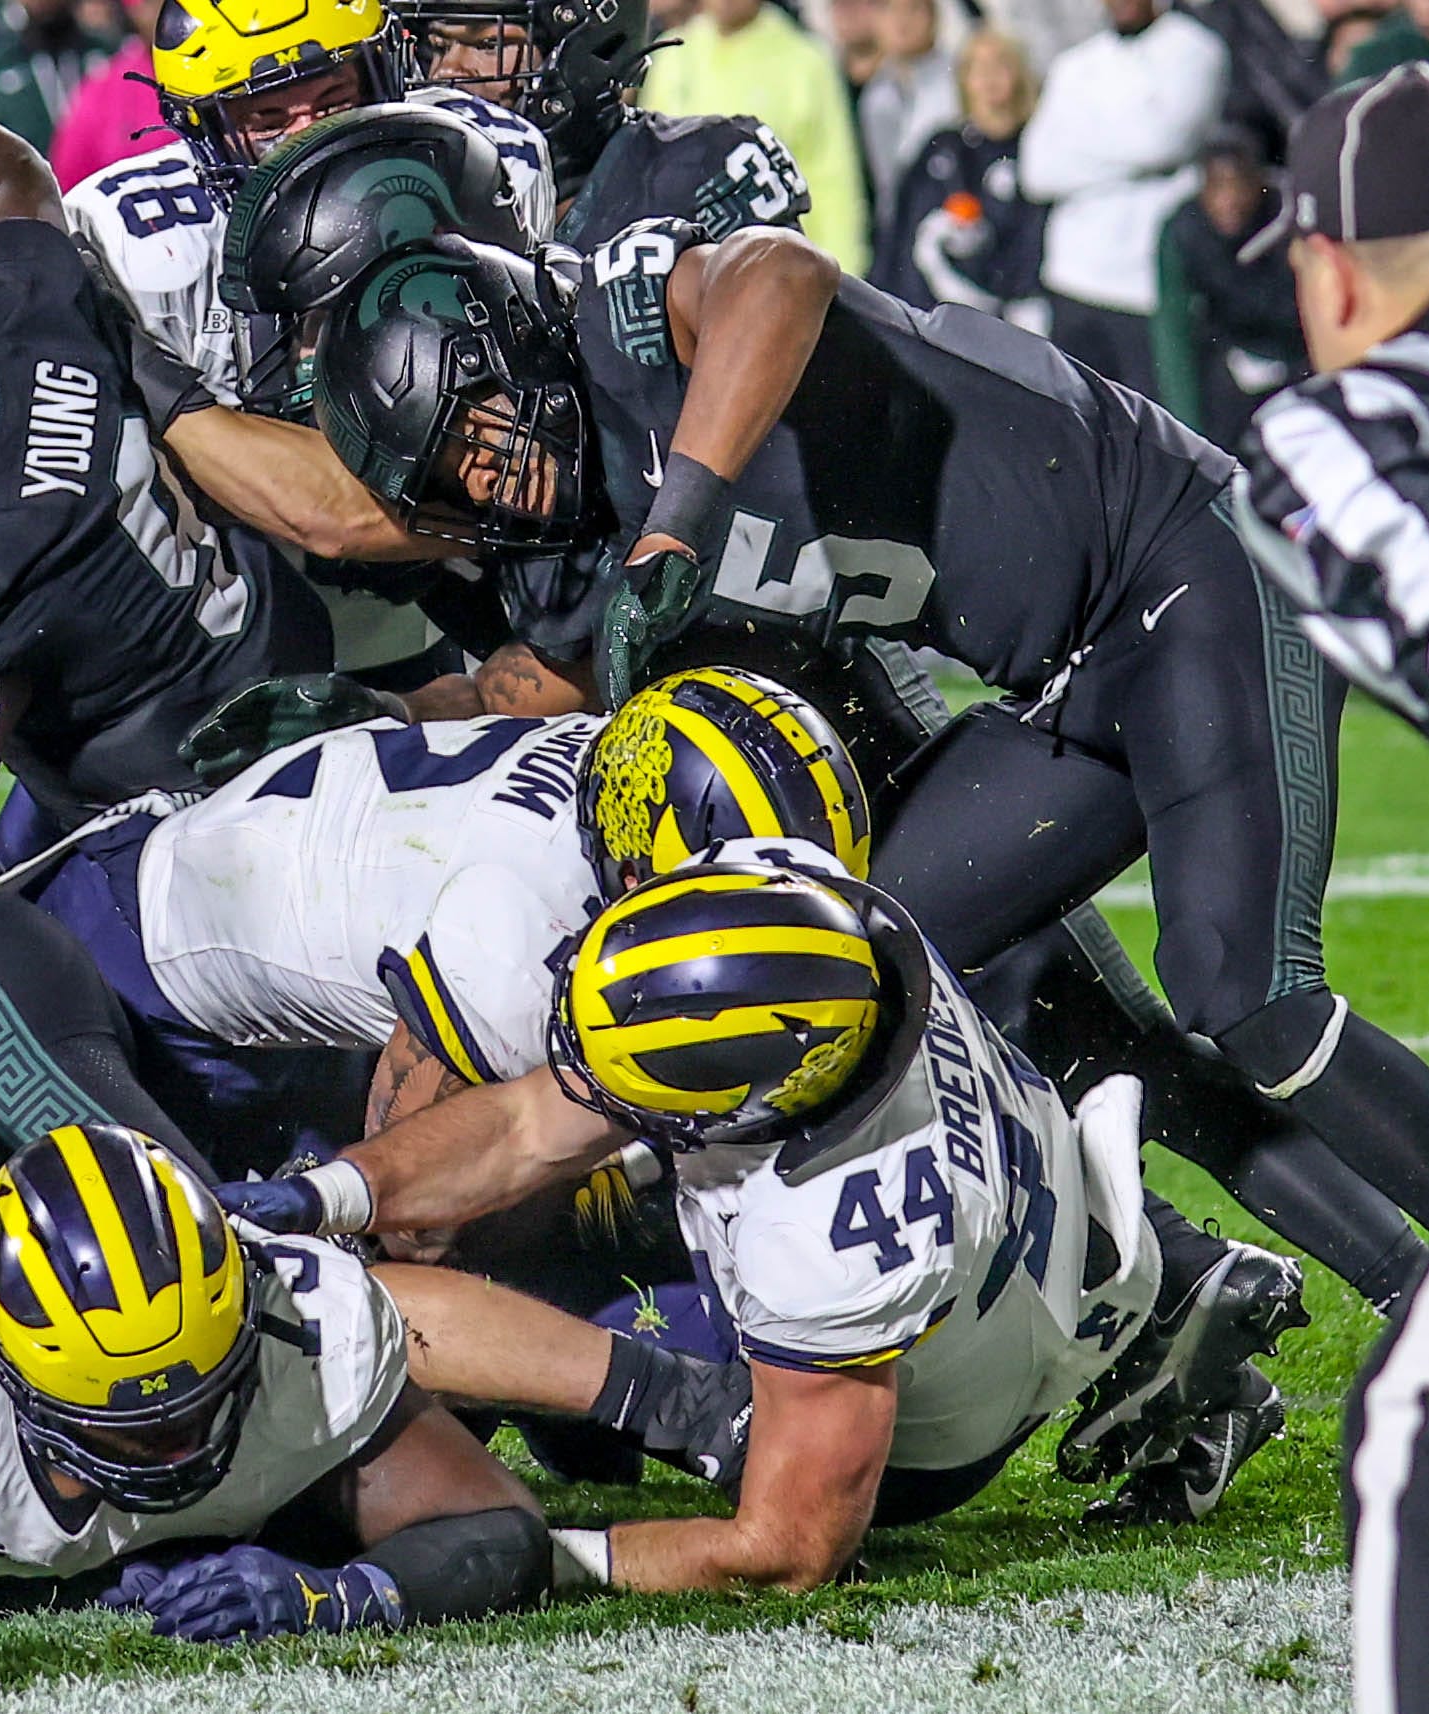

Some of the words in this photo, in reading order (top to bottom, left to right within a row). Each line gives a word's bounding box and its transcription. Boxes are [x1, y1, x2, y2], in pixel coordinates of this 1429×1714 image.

[275, 47, 302, 66] M
[95, 158, 216, 239] 18
[594, 232, 676, 288] 5
[21, 360, 99, 498] YOUNG
[712, 509, 937, 627] 5
[828, 1144, 955, 1277] 44
[139, 1373, 170, 1397] M
